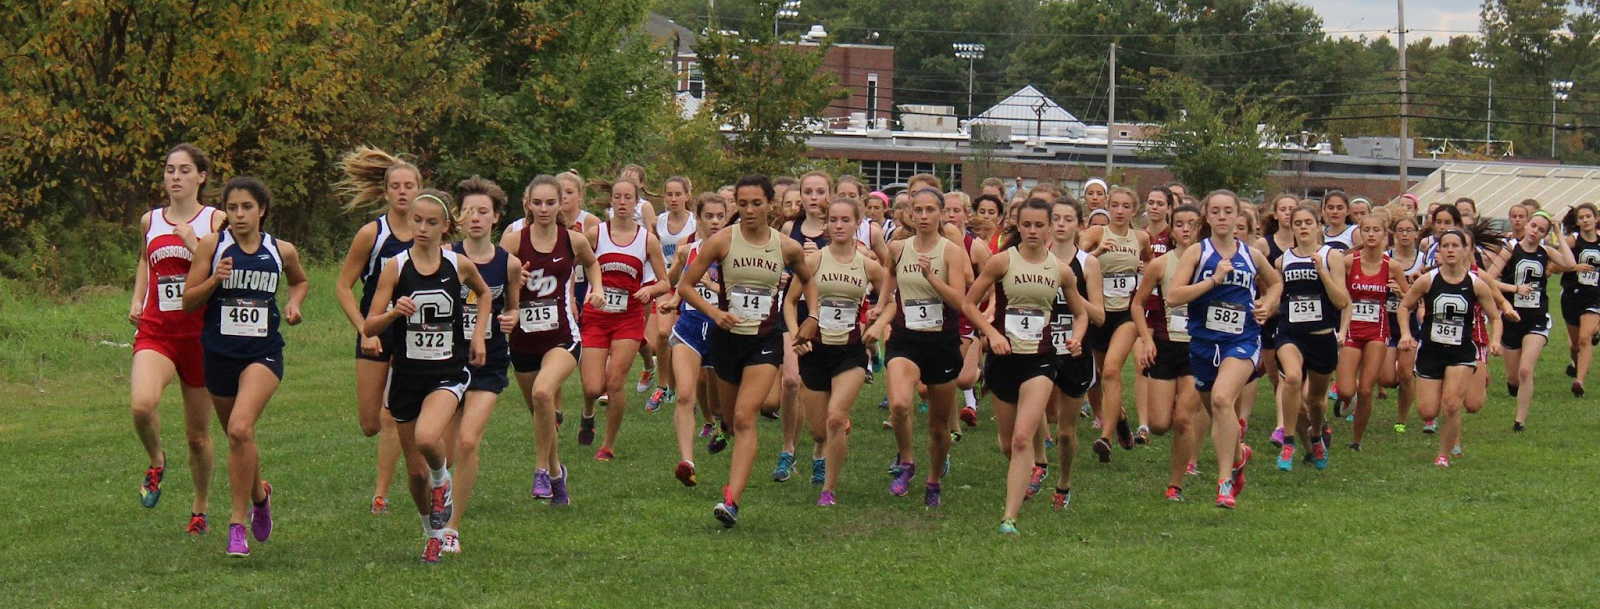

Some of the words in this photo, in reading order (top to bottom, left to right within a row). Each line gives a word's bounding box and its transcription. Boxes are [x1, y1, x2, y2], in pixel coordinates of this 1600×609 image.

[150, 245, 192, 267] TYNGSBOROU
[733, 257, 778, 273] ALVIRNE
[821, 272, 863, 288] ALVIRNE
[1014, 273, 1056, 289] ALVIRNE
[1203, 269, 1252, 289] SLEM
[1284, 269, 1319, 282] HBHS
[165, 283, 182, 299] 61
[1113, 278, 1126, 289] 18
[1351, 282, 1386, 293] CAMPBELL
[407, 289, 454, 324] C
[742, 295, 760, 309] 14
[1294, 301, 1316, 313] 254
[1356, 304, 1375, 315] 115
[1433, 293, 1468, 322] C
[229, 307, 260, 324] 460
[525, 307, 551, 322] 215
[834, 308, 842, 321] 2
[919, 306, 928, 319] 3
[1213, 308, 1240, 324] 582
[1020, 316, 1029, 330] 4
[1436, 324, 1457, 336] 364
[414, 332, 445, 348] 372
